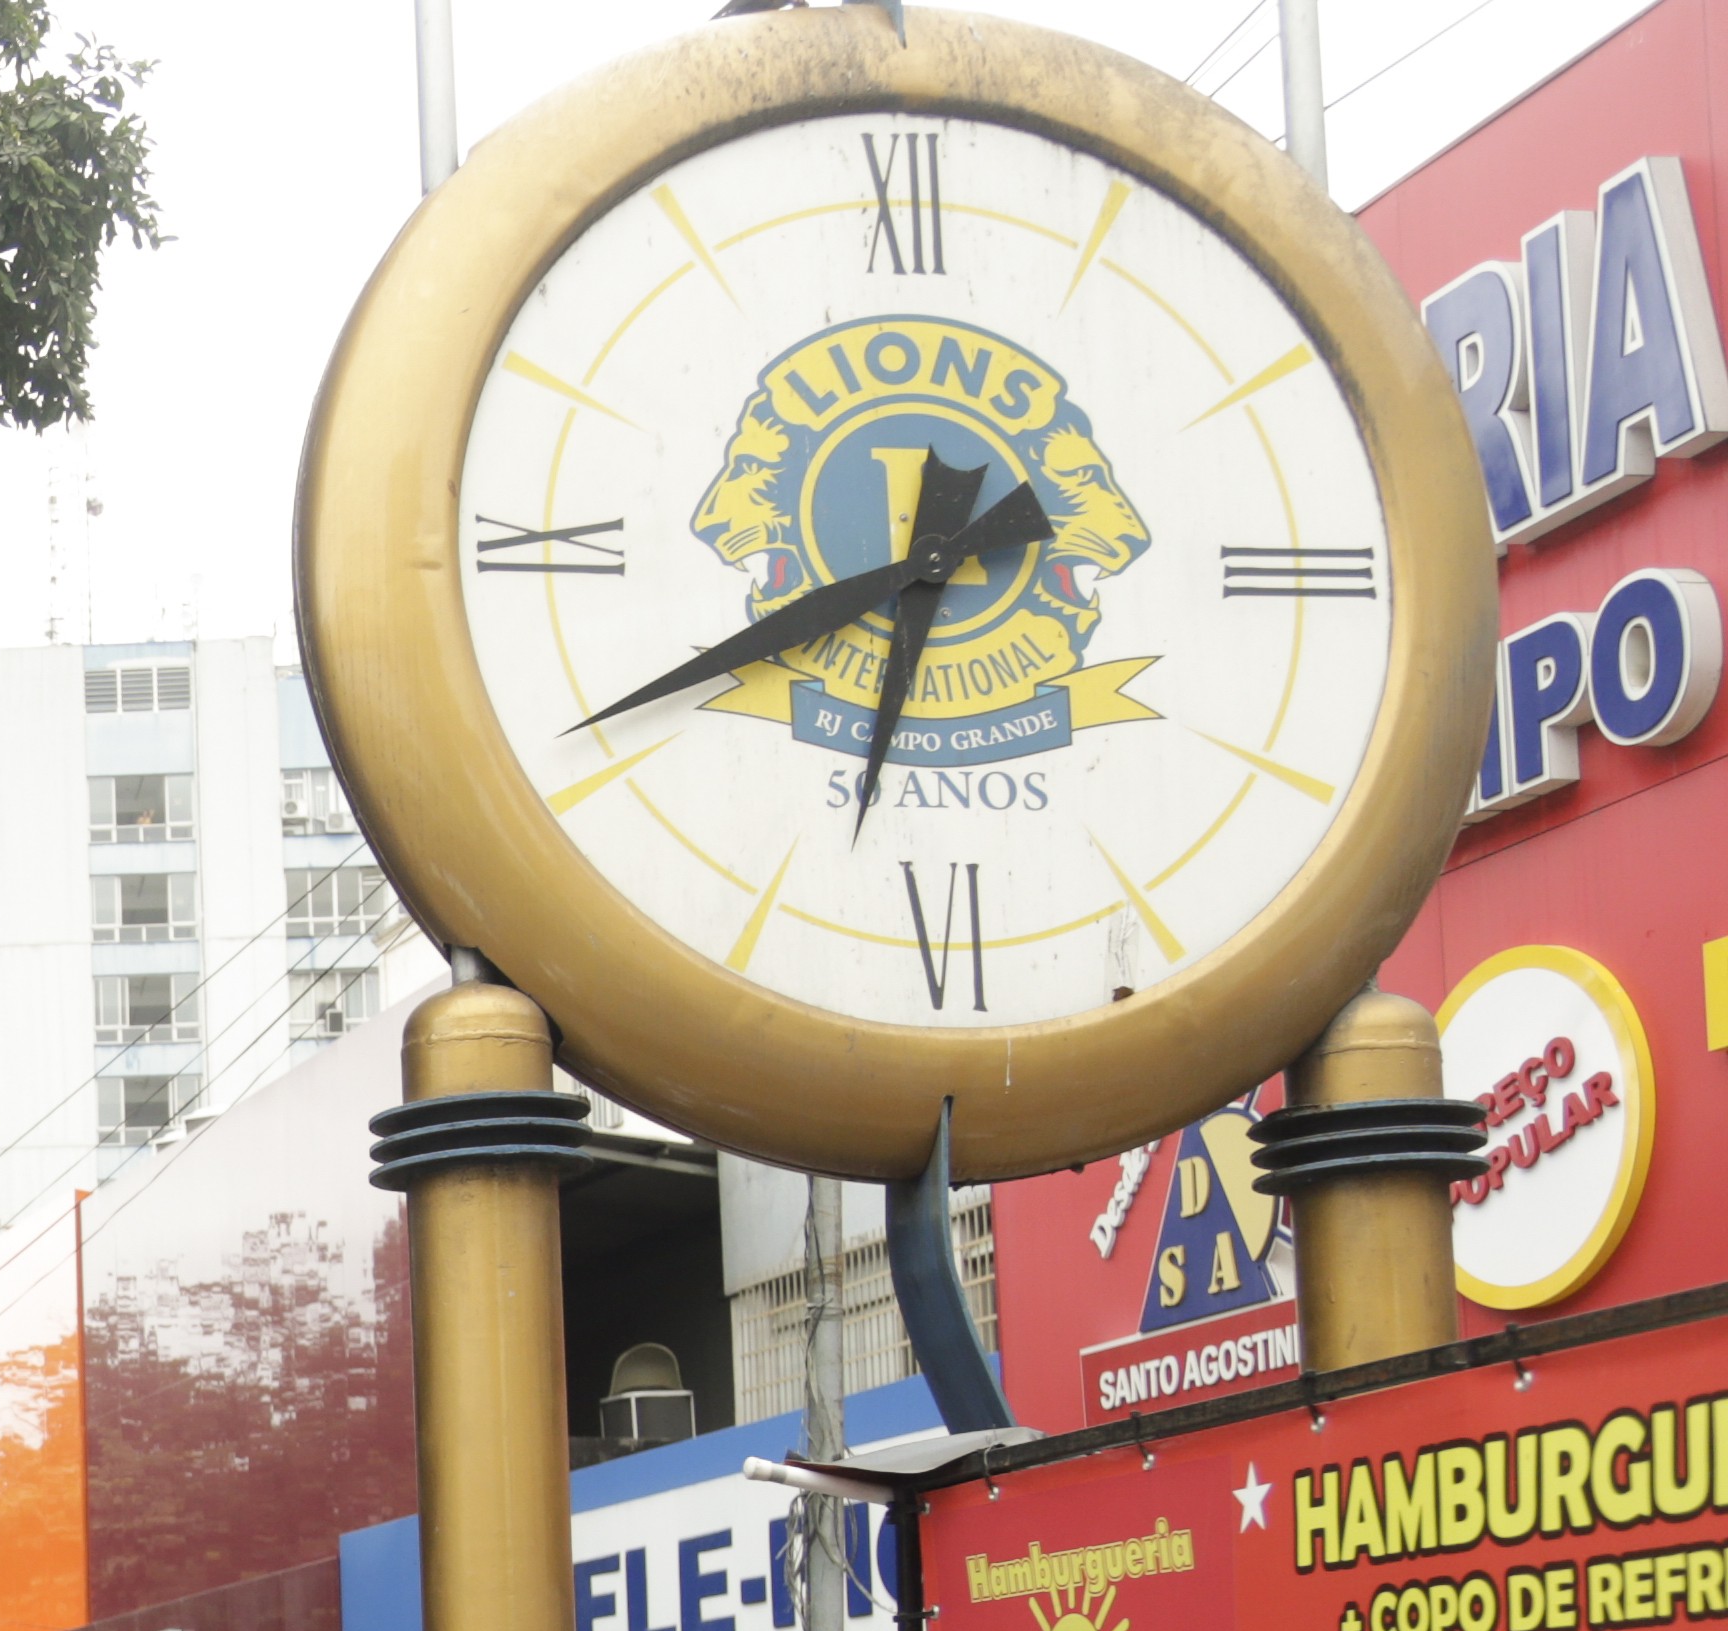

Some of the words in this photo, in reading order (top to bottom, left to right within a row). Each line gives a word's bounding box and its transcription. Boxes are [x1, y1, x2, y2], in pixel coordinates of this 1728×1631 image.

[860, 131, 947, 276] XII
[783, 331, 1042, 420] LIONS
[801, 632, 1056, 703] INTEATIONAL
[815, 709, 842, 737] RJ
[950, 709, 1059, 751] GRANDE
[826, 770, 881, 810] 50
[894, 771, 1049, 812] ANOS
[899, 860, 987, 1013] VI
[1478, 1036, 1576, 1131] REÇO
[1178, 1156, 1212, 1219] D
[1157, 1245, 1187, 1308] S
[1208, 1231, 1241, 1295] A
[1098, 1358, 1180, 1411] SANTO
[1181, 1323, 1300, 1391] AGOSTIN
[966, 1517, 1195, 1604] Hamburgueria
[1586, 1548, 1728, 1625] REFR
